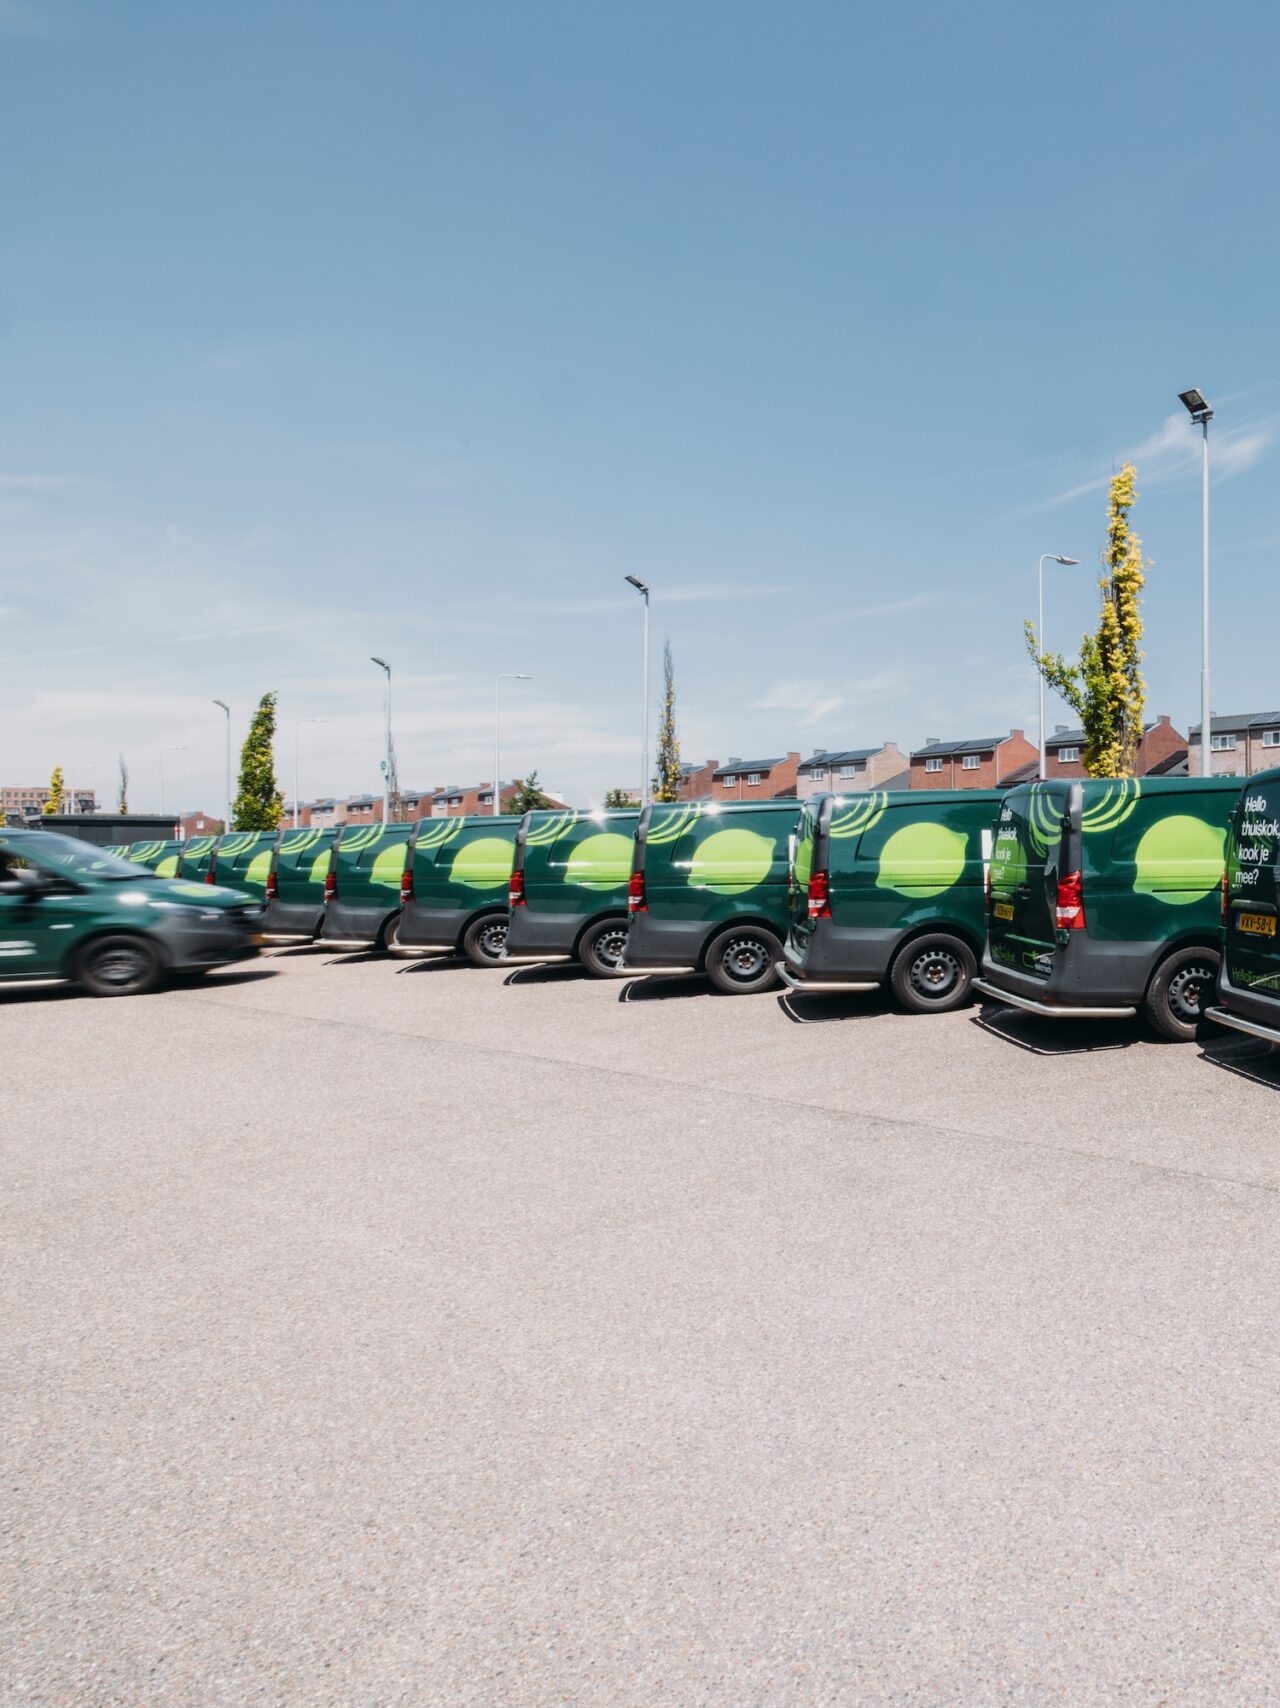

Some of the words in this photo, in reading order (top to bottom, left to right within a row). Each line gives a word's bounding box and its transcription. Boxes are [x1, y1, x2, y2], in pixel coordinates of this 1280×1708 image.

[1244, 795, 1267, 813] Hello
[1241, 819, 1280, 840] thuiskok,
[1238, 843, 1259, 861] kook
[1258, 844, 1269, 866] je
[1235, 869, 1259, 884] mee?
